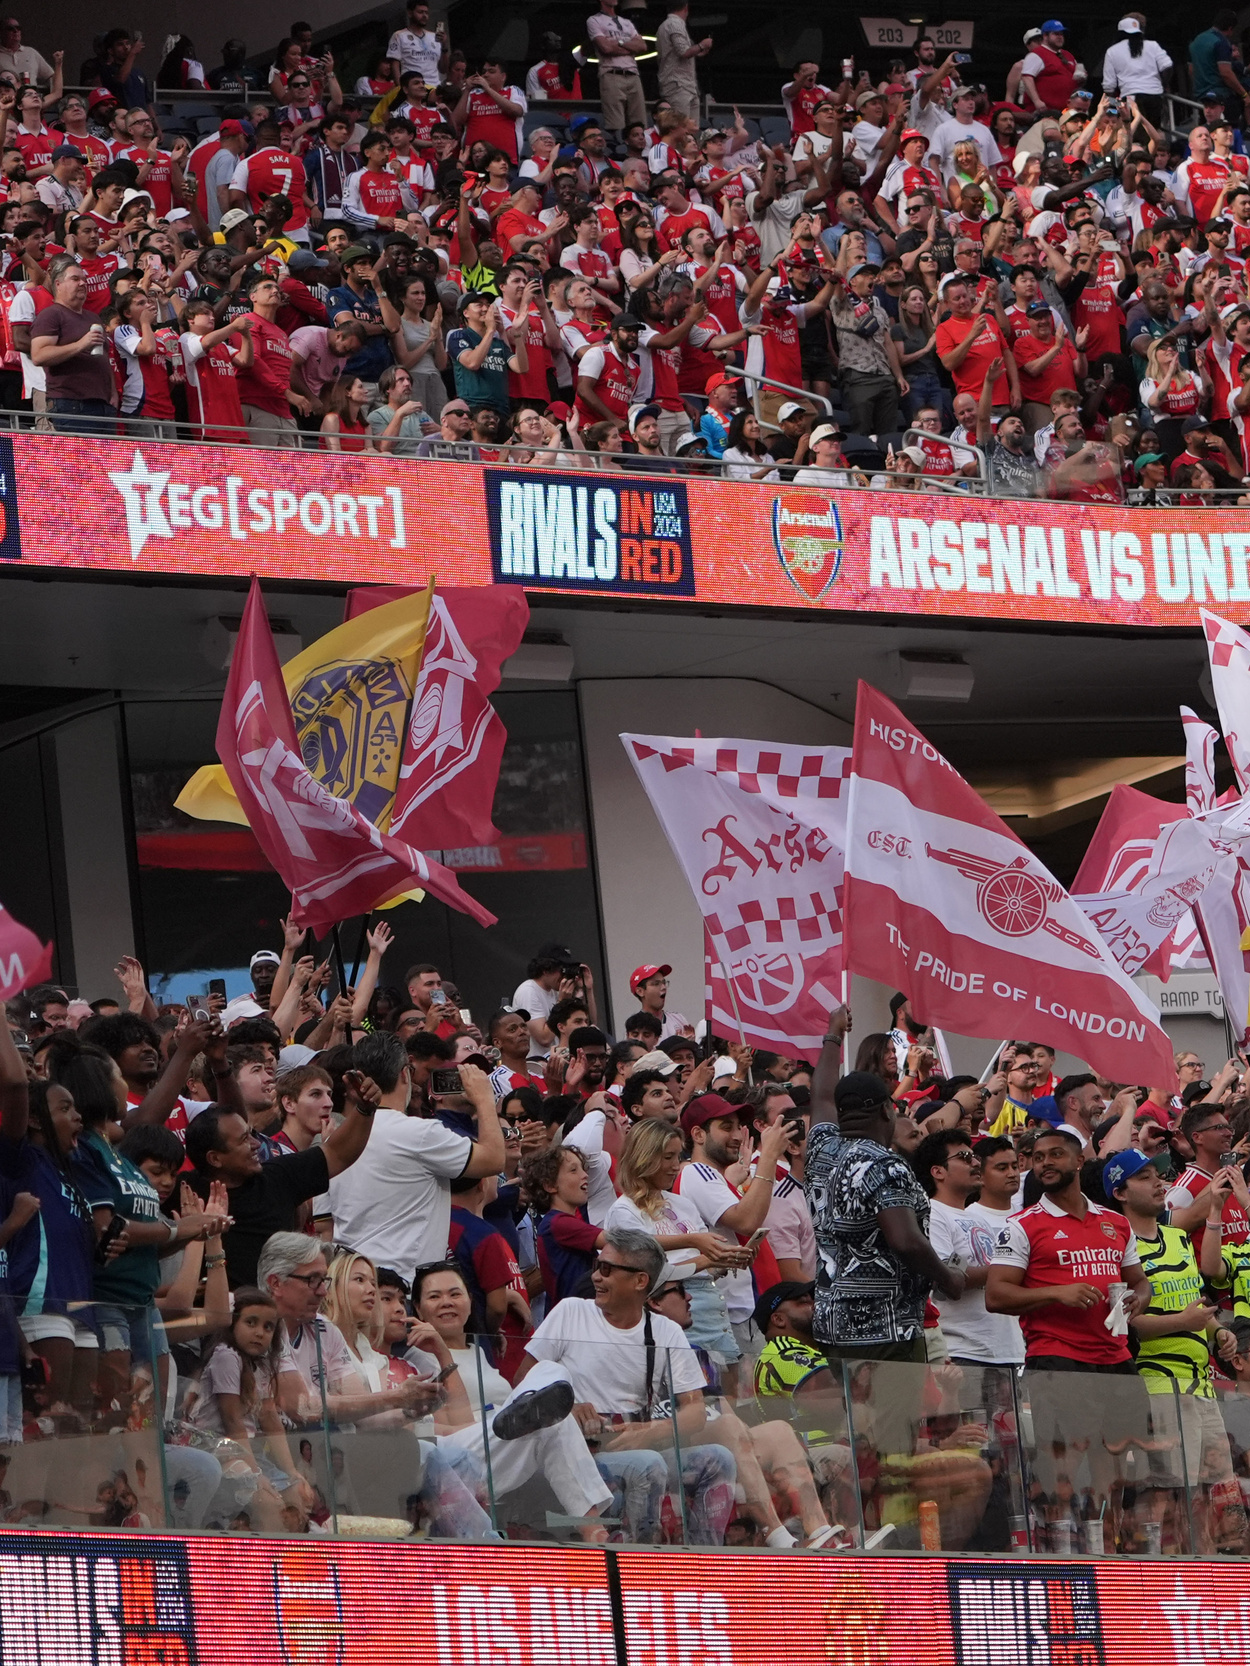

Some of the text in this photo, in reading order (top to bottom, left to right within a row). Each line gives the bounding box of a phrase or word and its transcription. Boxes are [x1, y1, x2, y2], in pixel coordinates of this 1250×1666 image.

[878, 28, 904, 43] 203
[936, 29, 961, 45] 202
[269, 155, 291, 164] SAKA
[267, 168, 287, 198] 7
[653, 491, 677, 515] USA
[654, 514, 682, 538] 2024
[779, 507, 837, 528] Arsenal
[500, 481, 654, 581] RIVALS IN
[620, 538, 681, 582] RED
[869, 515, 1081, 599] ARSENAL
[1080, 529, 1145, 602] VS
[914, 950, 986, 995] PRIDE
[992, 981, 1028, 1005] OF
[1035, 995, 1147, 1043] LONDON
[1161, 990, 1198, 1007] RAMP
[1056, 1246, 1123, 1266] Emirates
[1072, 1261, 1119, 1278] FLY BETTER
[1163, 1292, 1176, 1311] FLY
